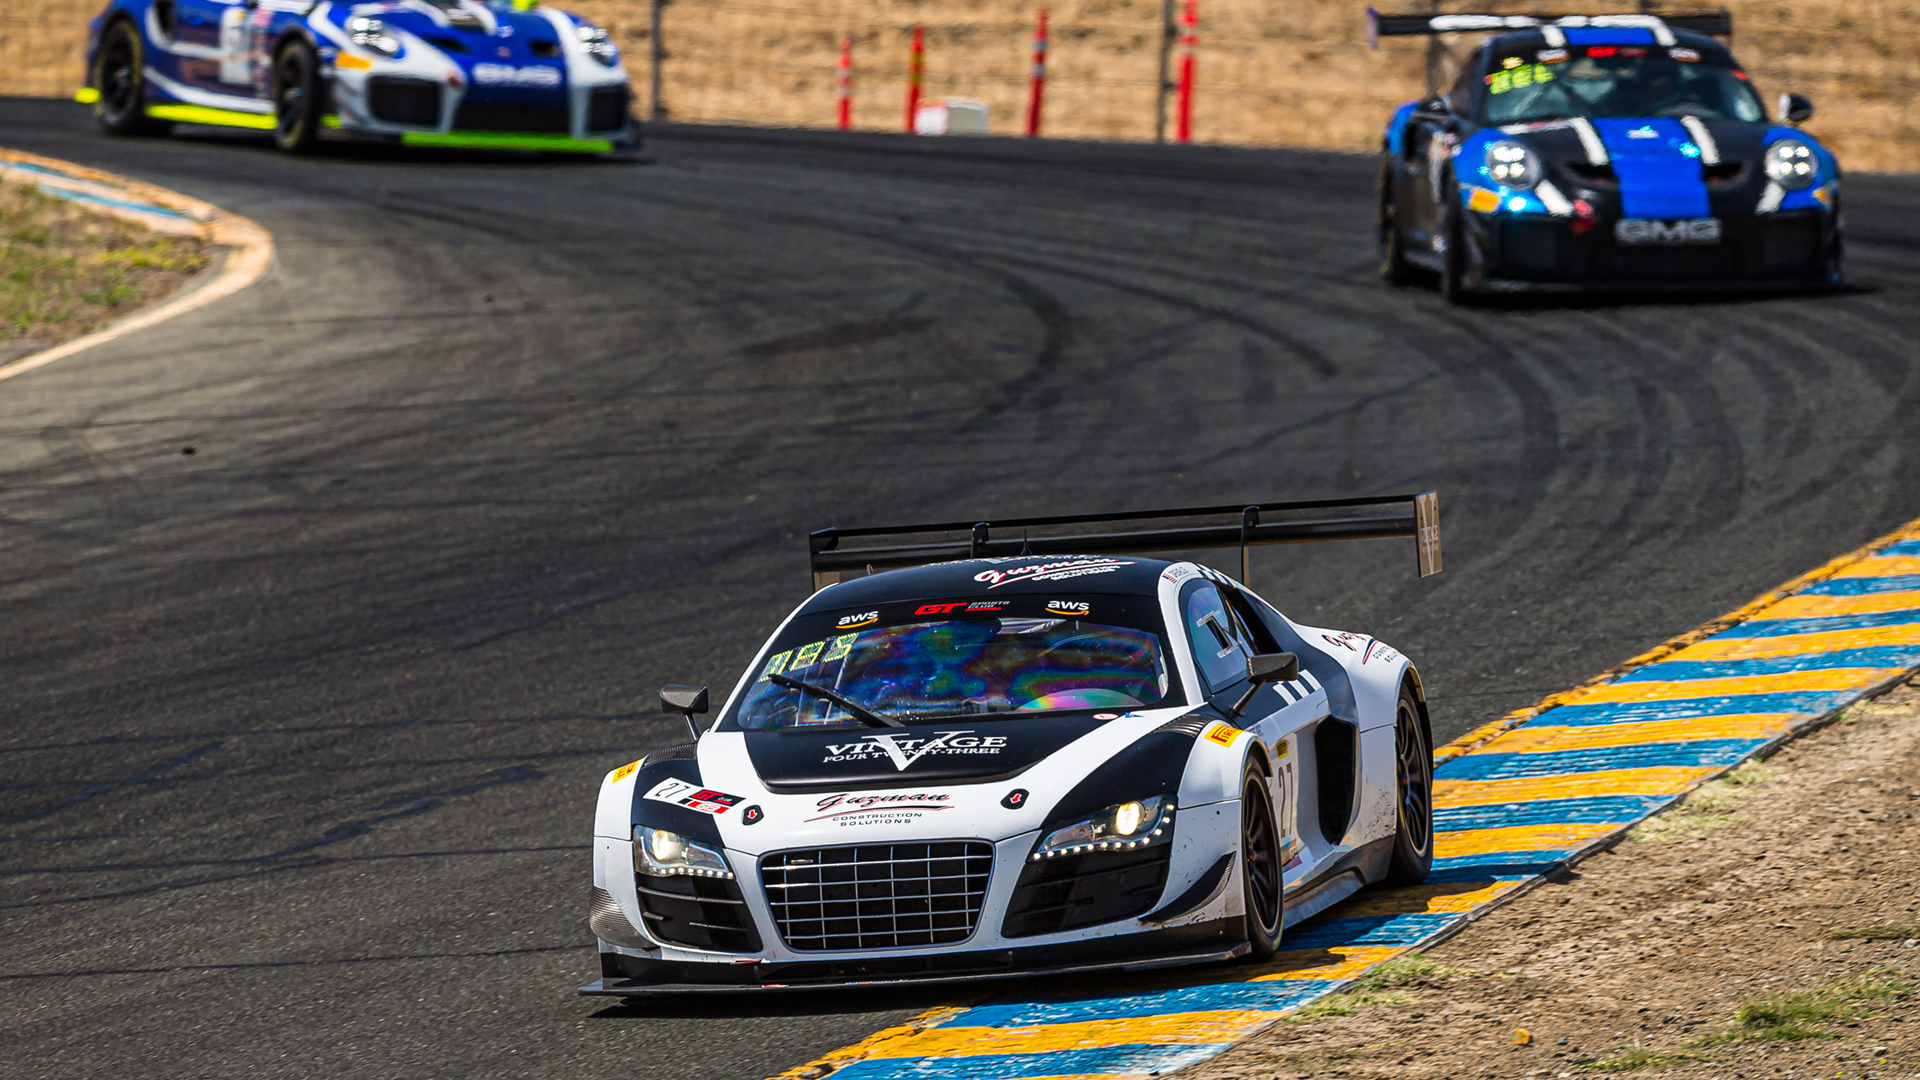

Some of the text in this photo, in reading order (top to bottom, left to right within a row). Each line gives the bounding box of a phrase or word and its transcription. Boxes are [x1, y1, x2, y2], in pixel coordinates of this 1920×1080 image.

[1615, 218, 1721, 243] GMG
[974, 558, 1119, 584] Guzman
[914, 602, 967, 615] GT
[1047, 600, 1090, 612] aws
[837, 610, 879, 626] aws
[823, 753, 868, 763] FOUR
[654, 782, 690, 799] 27
[691, 790, 725, 801] GT
[816, 793, 950, 812] Guzman
[1278, 762, 1294, 839] 27
[832, 812, 923, 822] CONSTRUCTION
[840, 819, 912, 827] SOLUTIONS
